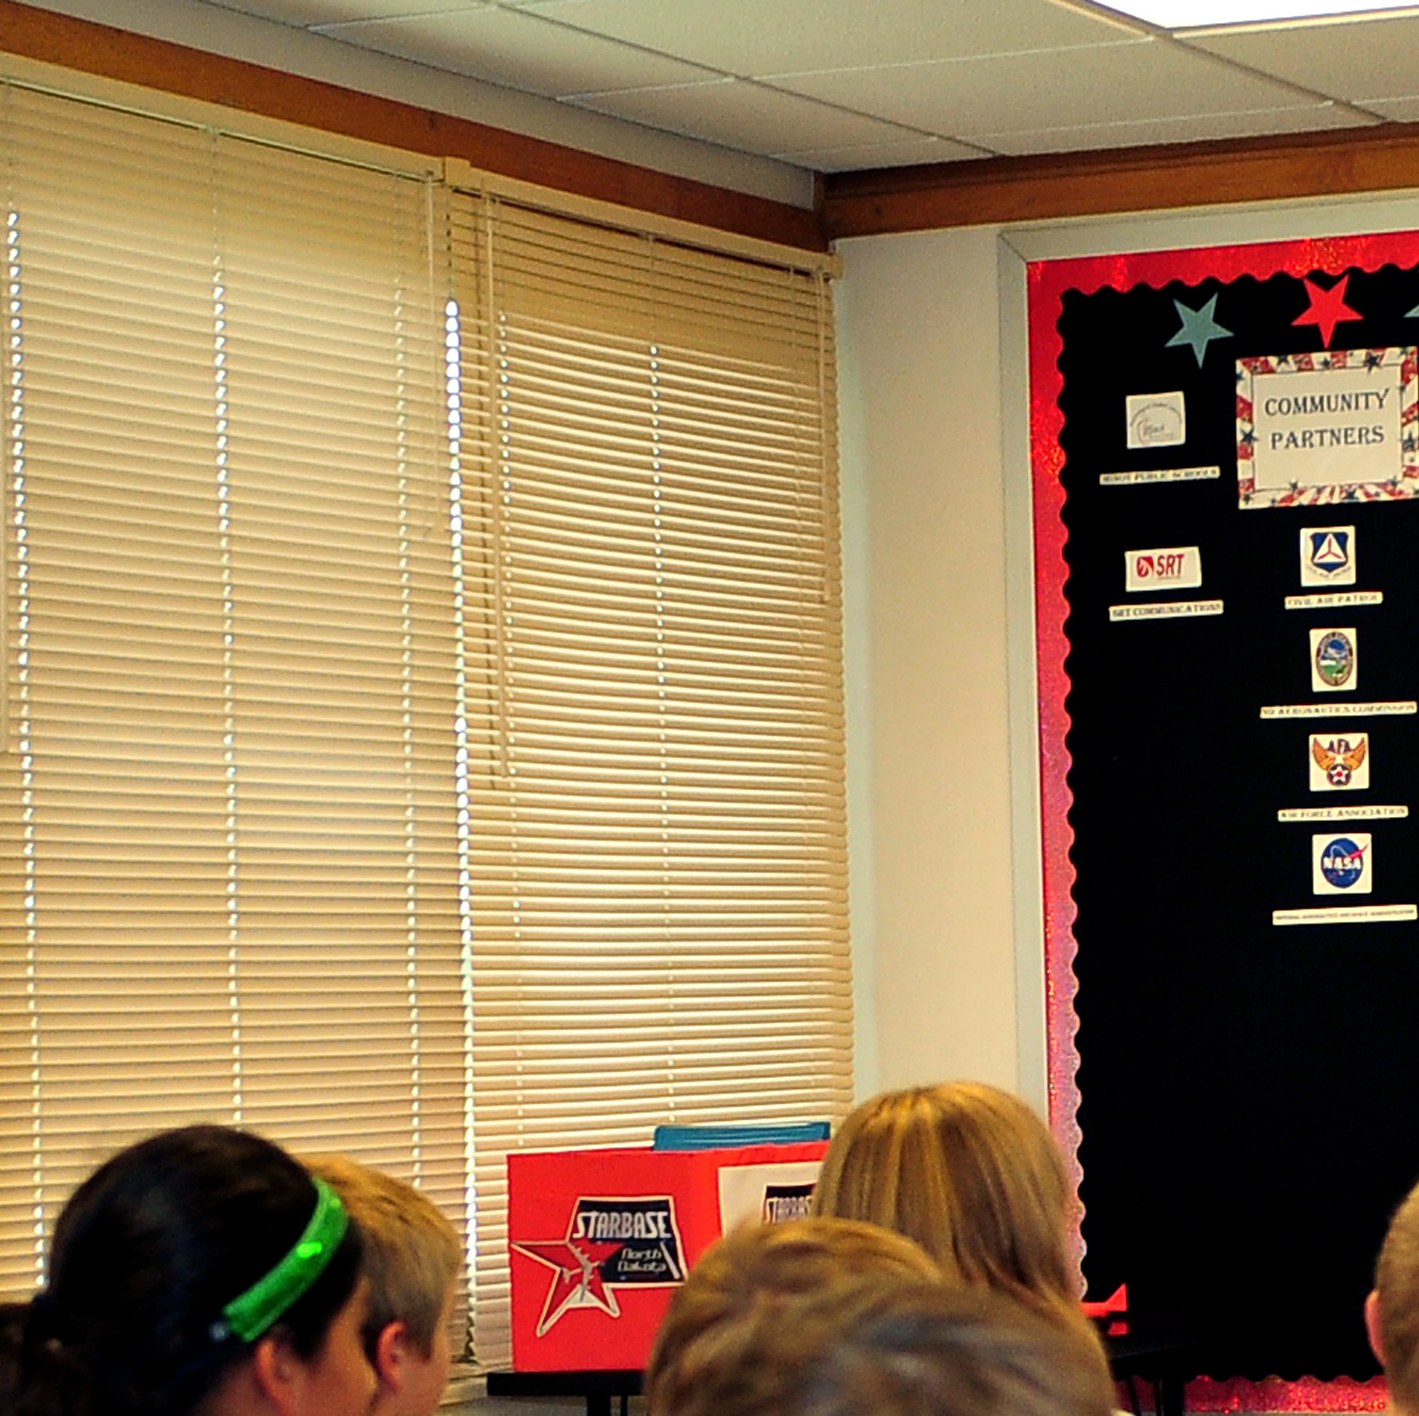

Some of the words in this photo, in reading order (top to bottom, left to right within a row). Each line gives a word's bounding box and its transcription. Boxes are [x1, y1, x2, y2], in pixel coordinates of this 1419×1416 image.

[1264, 387, 1389, 416] COMMUNITY
[1271, 425, 1385, 450] PARTNERS
[1156, 553, 1185, 577] SRT
[1323, 856, 1362, 870] NASA
[572, 1211, 672, 1240] STARBASE
[621, 1247, 663, 1260] North
[616, 1259, 668, 1273] Dakota
